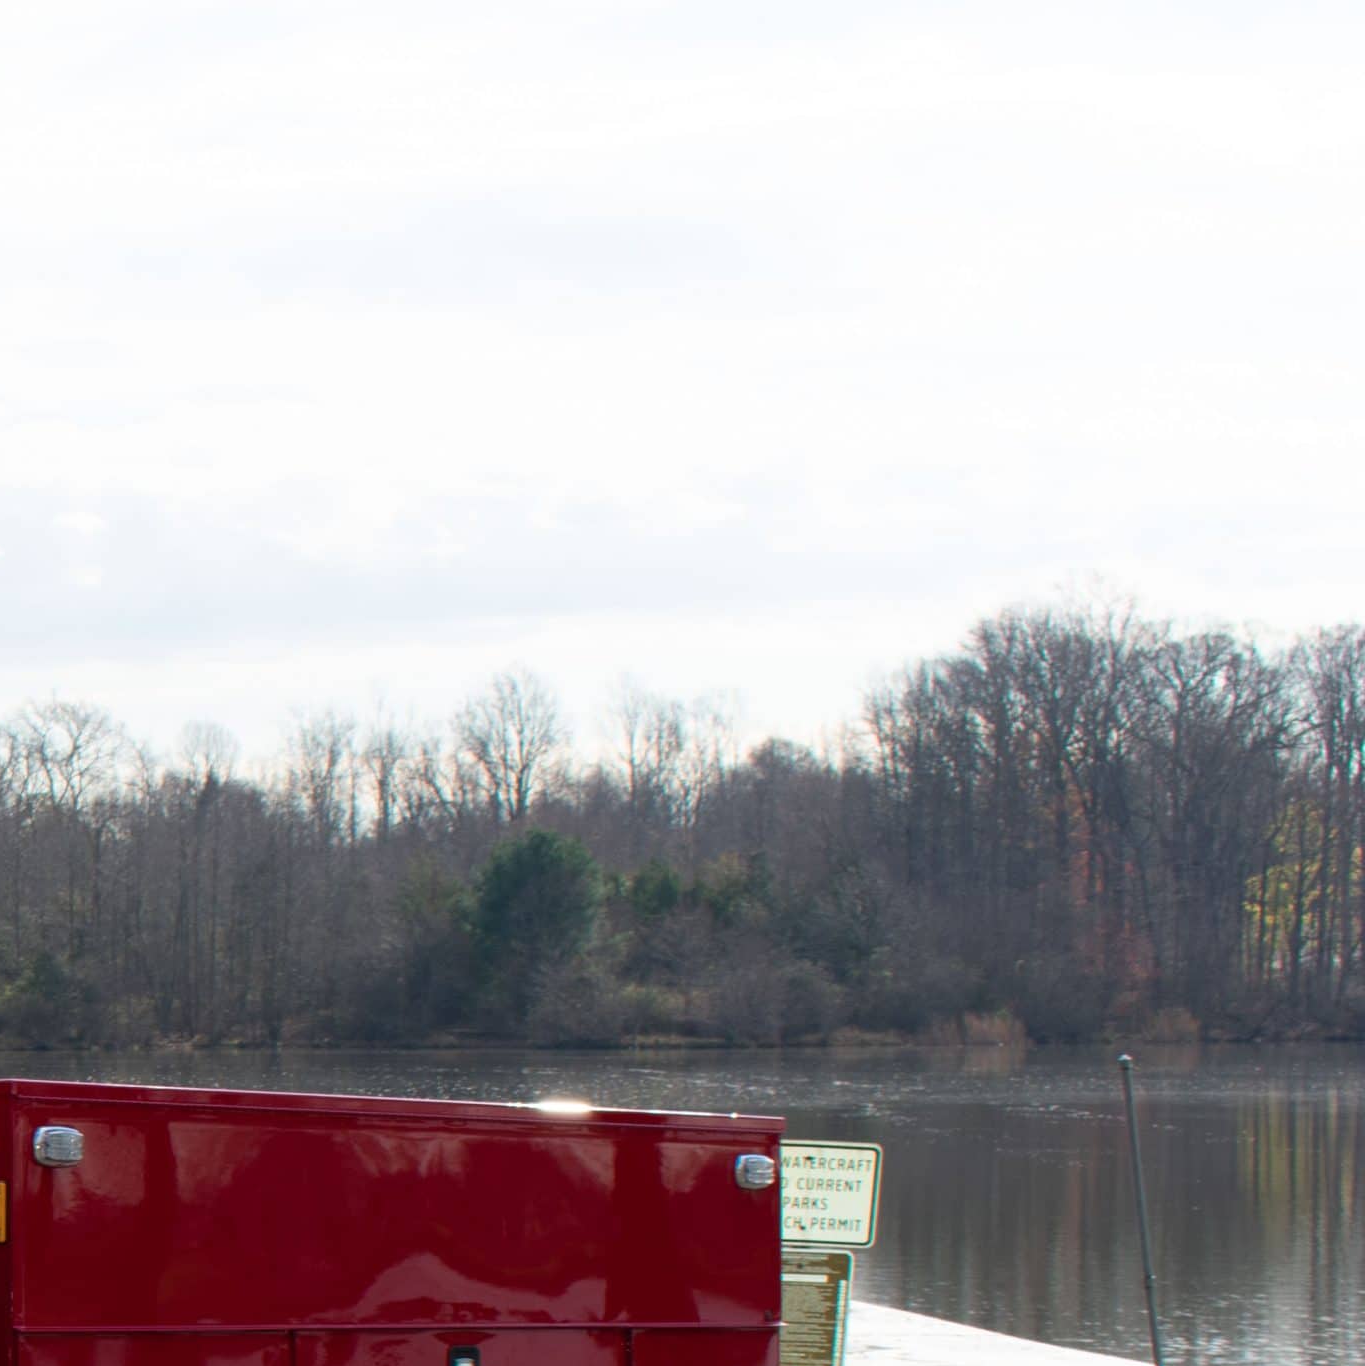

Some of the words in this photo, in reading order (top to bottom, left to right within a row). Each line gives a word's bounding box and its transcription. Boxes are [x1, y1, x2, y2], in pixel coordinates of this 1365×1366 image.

[780, 1156, 873, 1172] WATERCRAFT
[796, 1177, 862, 1192] CURRENT
[782, 1196, 828, 1210] PARKS
[810, 1217, 862, 1232] PERMIT
